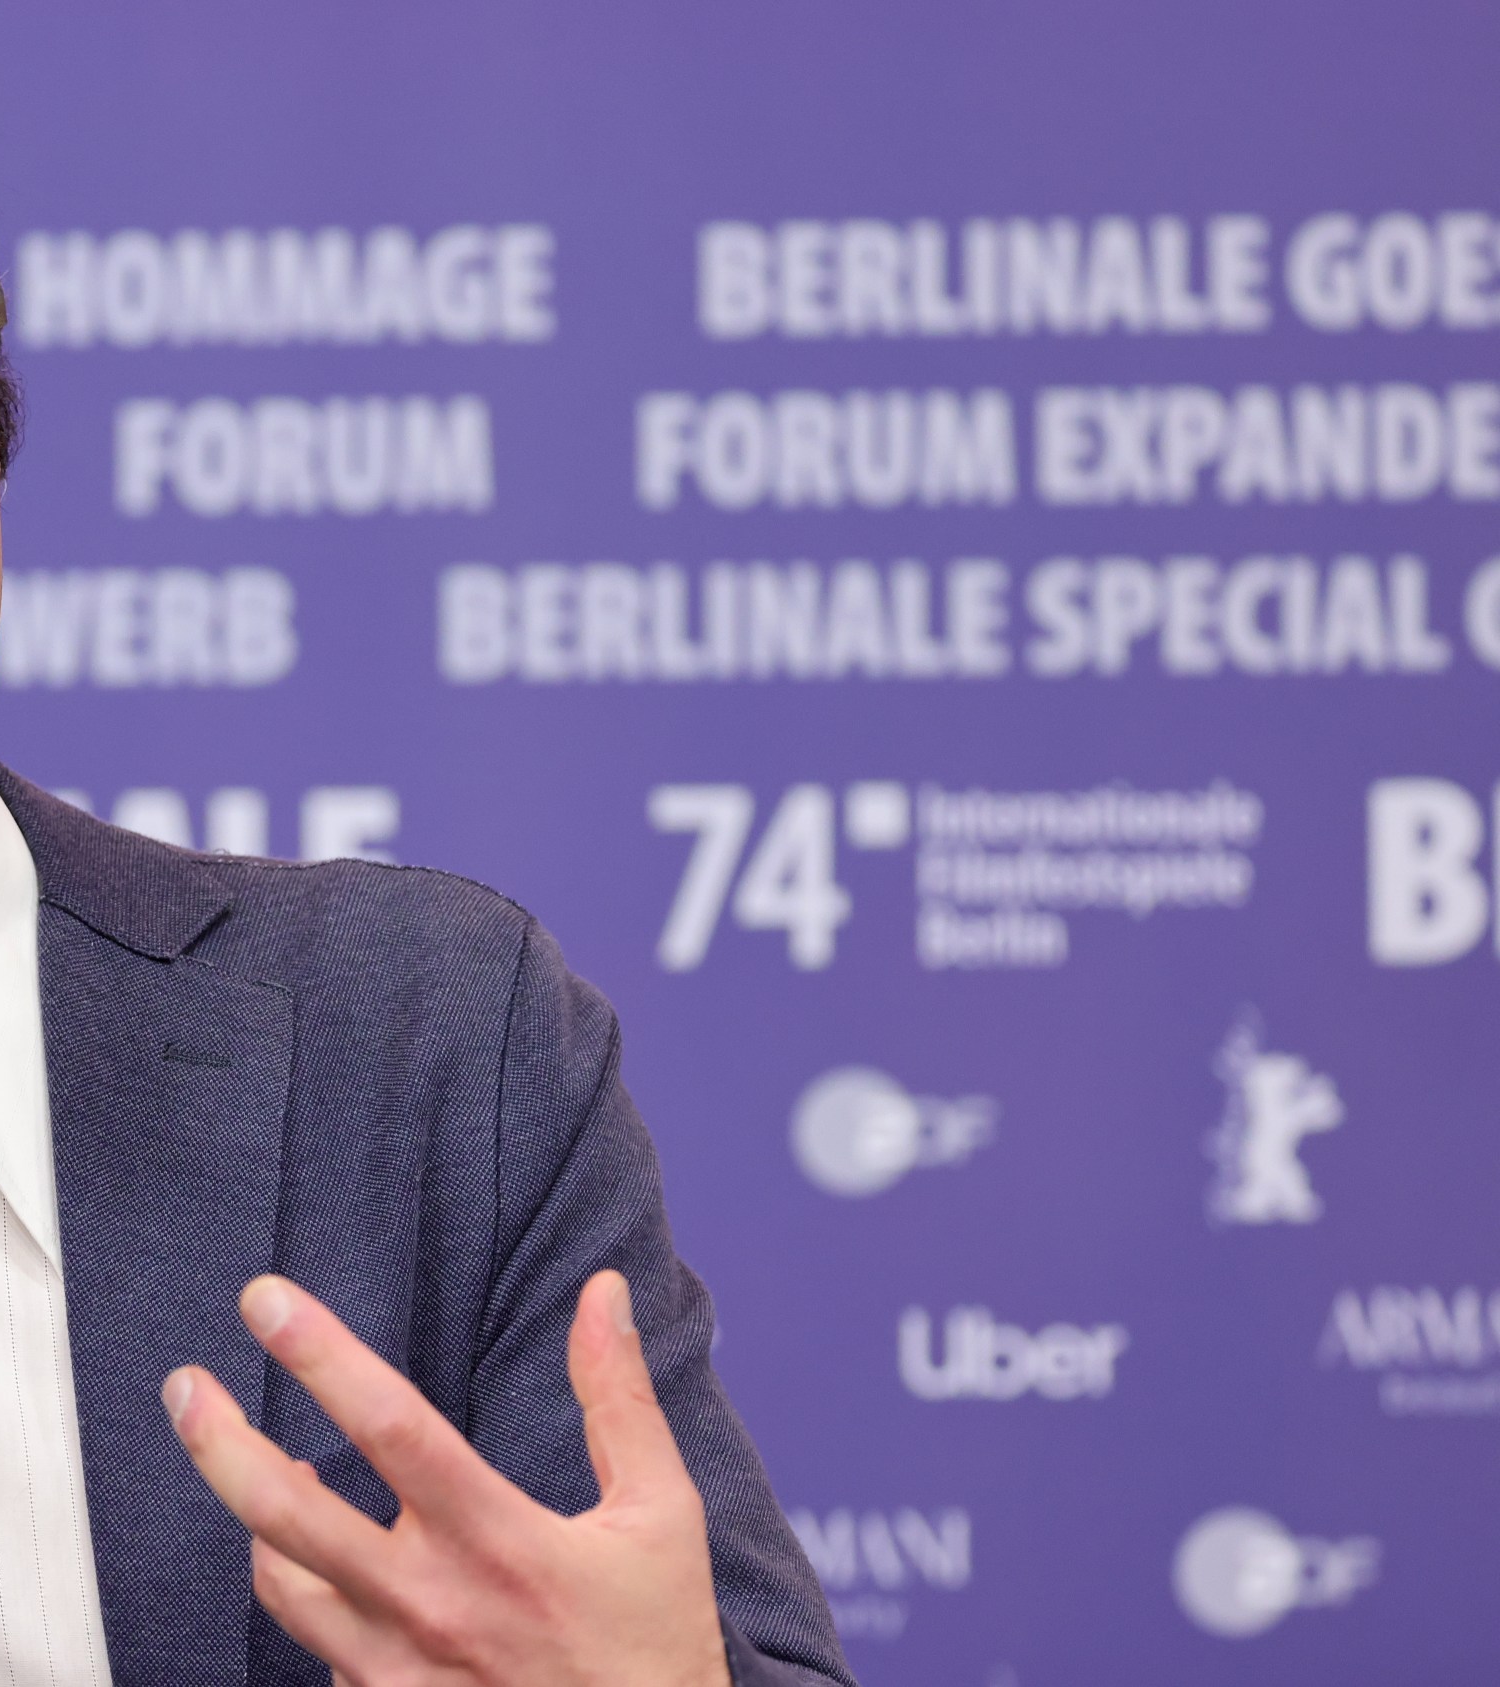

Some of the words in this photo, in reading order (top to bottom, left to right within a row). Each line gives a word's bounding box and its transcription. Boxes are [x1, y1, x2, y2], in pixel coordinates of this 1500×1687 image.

[16, 224, 555, 348] HOMMAGE
[698, 213, 1271, 340] BERLINALE
[1285, 210, 1500, 331] GOE
[114, 396, 494, 516] FORUM
[635, 390, 1017, 510] FORUM
[437, 558, 1011, 684] BERLINALE
[1025, 554, 1451, 677] SPECIAL
[648, 783, 852, 971] 74
[916, 905, 1068, 969] Berlin
[900, 1307, 1128, 1401] Uber
